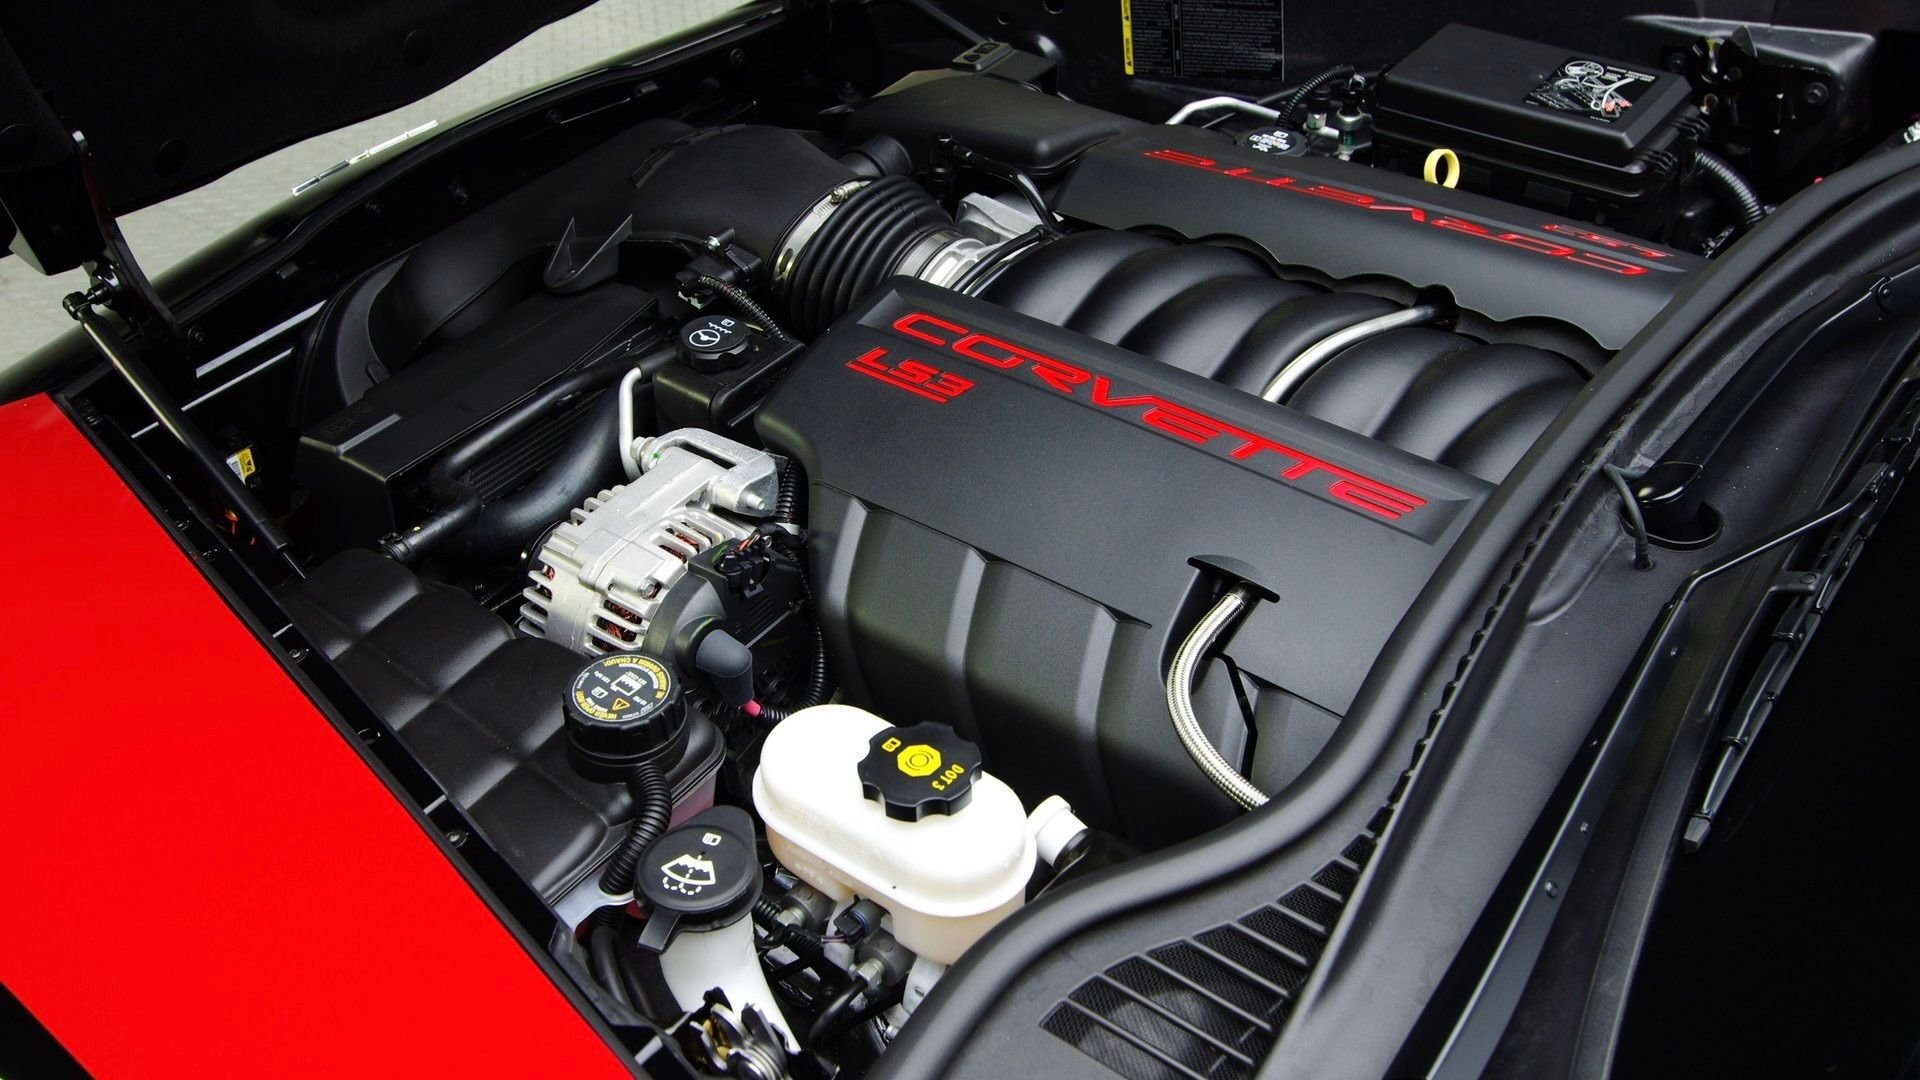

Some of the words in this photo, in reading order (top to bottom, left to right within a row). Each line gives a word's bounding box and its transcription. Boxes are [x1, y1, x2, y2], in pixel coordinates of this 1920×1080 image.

[1144, 149, 1649, 277] CORVETTE
[848, 347, 976, 403] LS3
[891, 312, 1427, 520] CORVETTE
[594, 711, 618, 719] NEVER
[931, 780, 945, 791] 3
[940, 764, 965, 785] DOT
